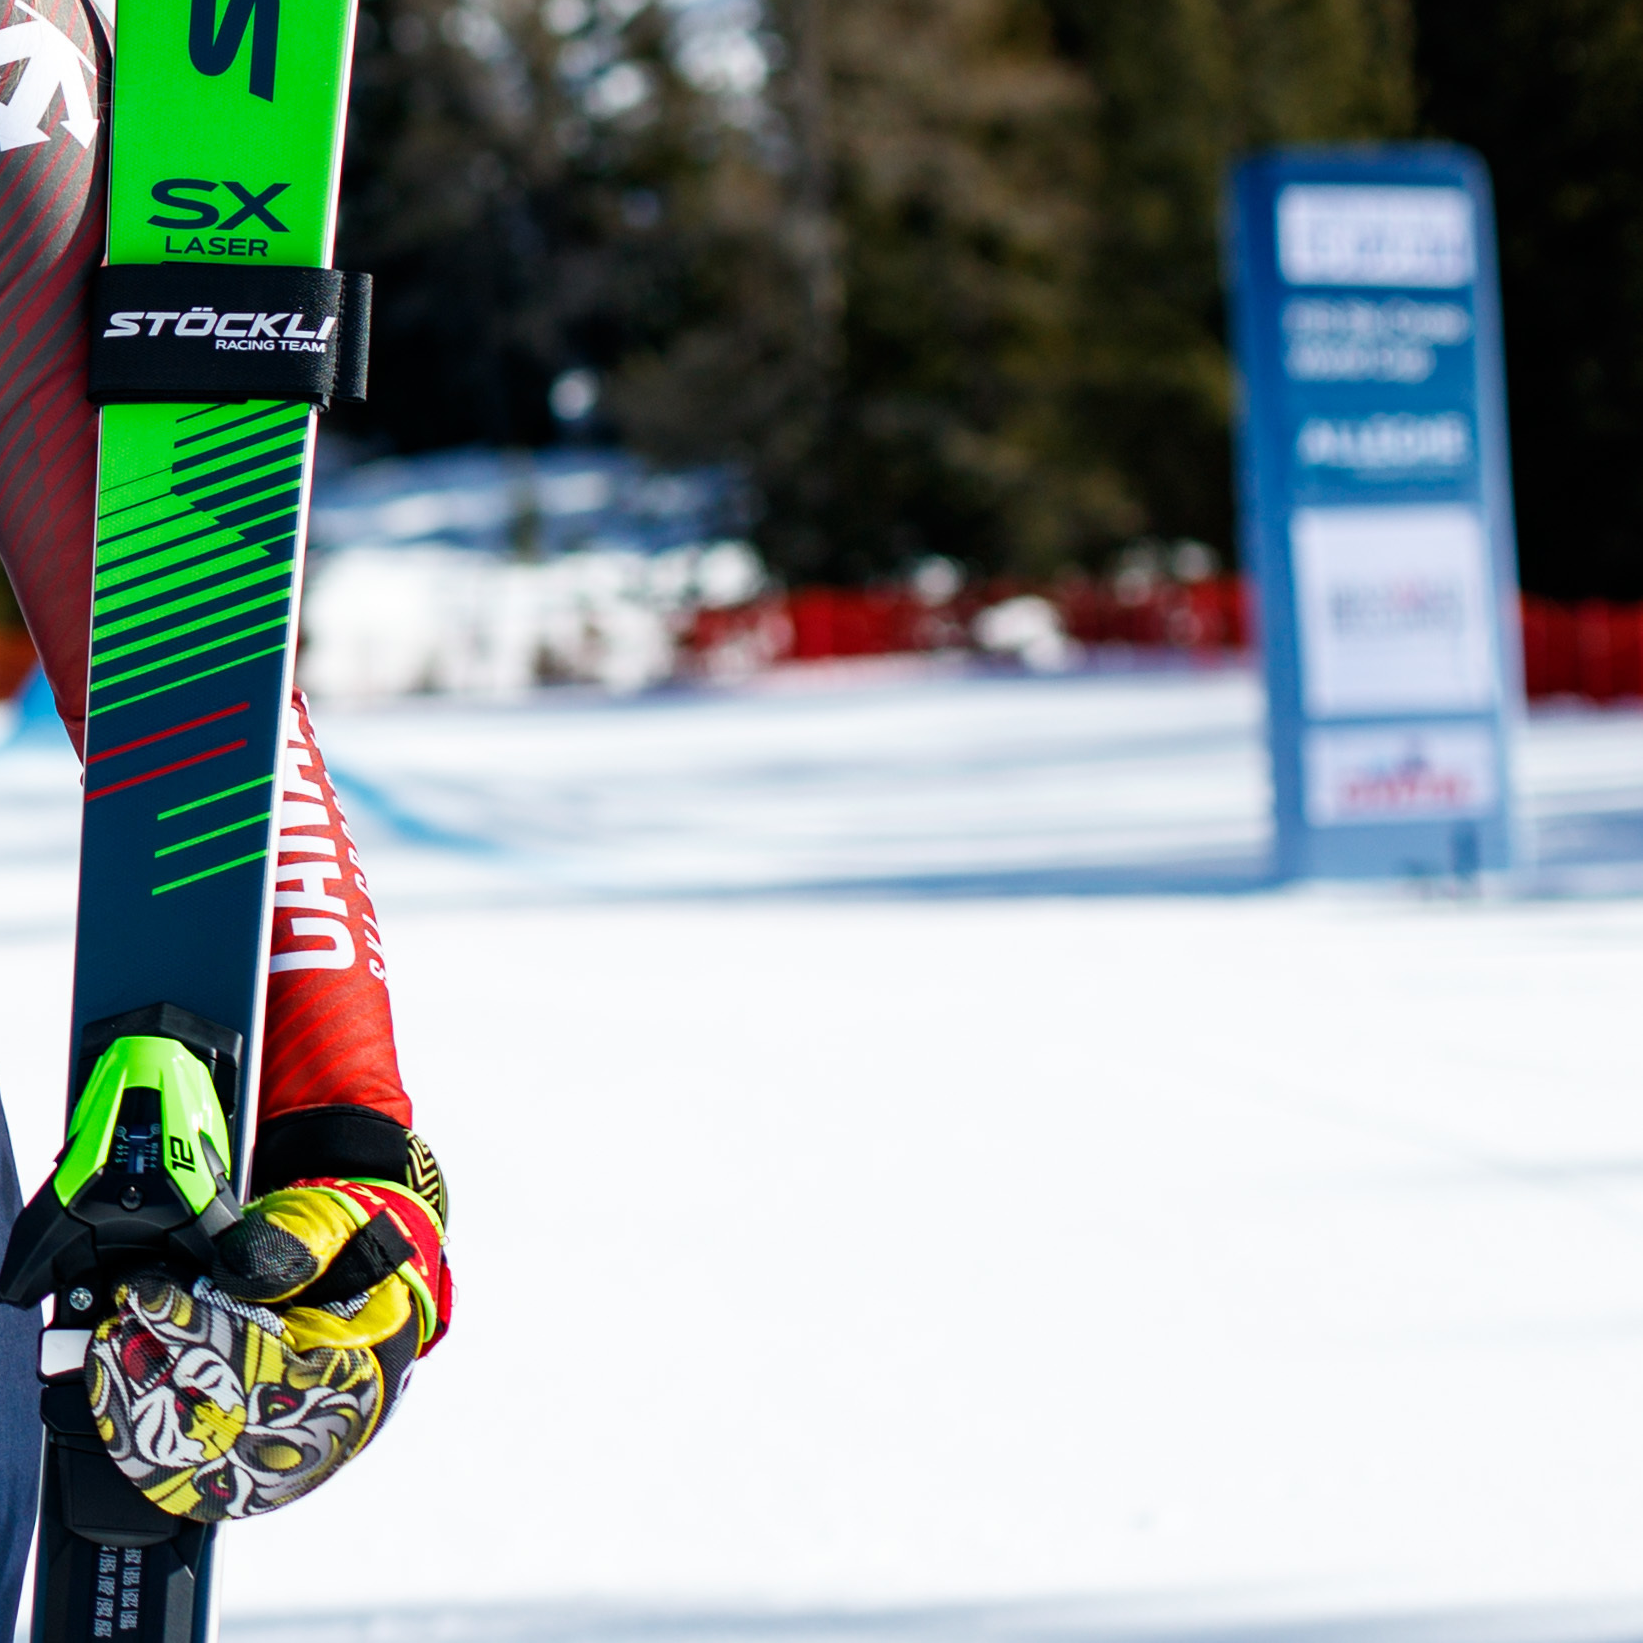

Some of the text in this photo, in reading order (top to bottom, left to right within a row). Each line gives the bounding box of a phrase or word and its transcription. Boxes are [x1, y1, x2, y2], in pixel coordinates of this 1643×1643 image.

[147, 178, 292, 233] SX
[165, 235, 269, 257] LASER
[103, 307, 336, 341] STÖCKLI
[215, 338, 326, 354] RACING TEAM
[169, 1135, 196, 1173] 12
